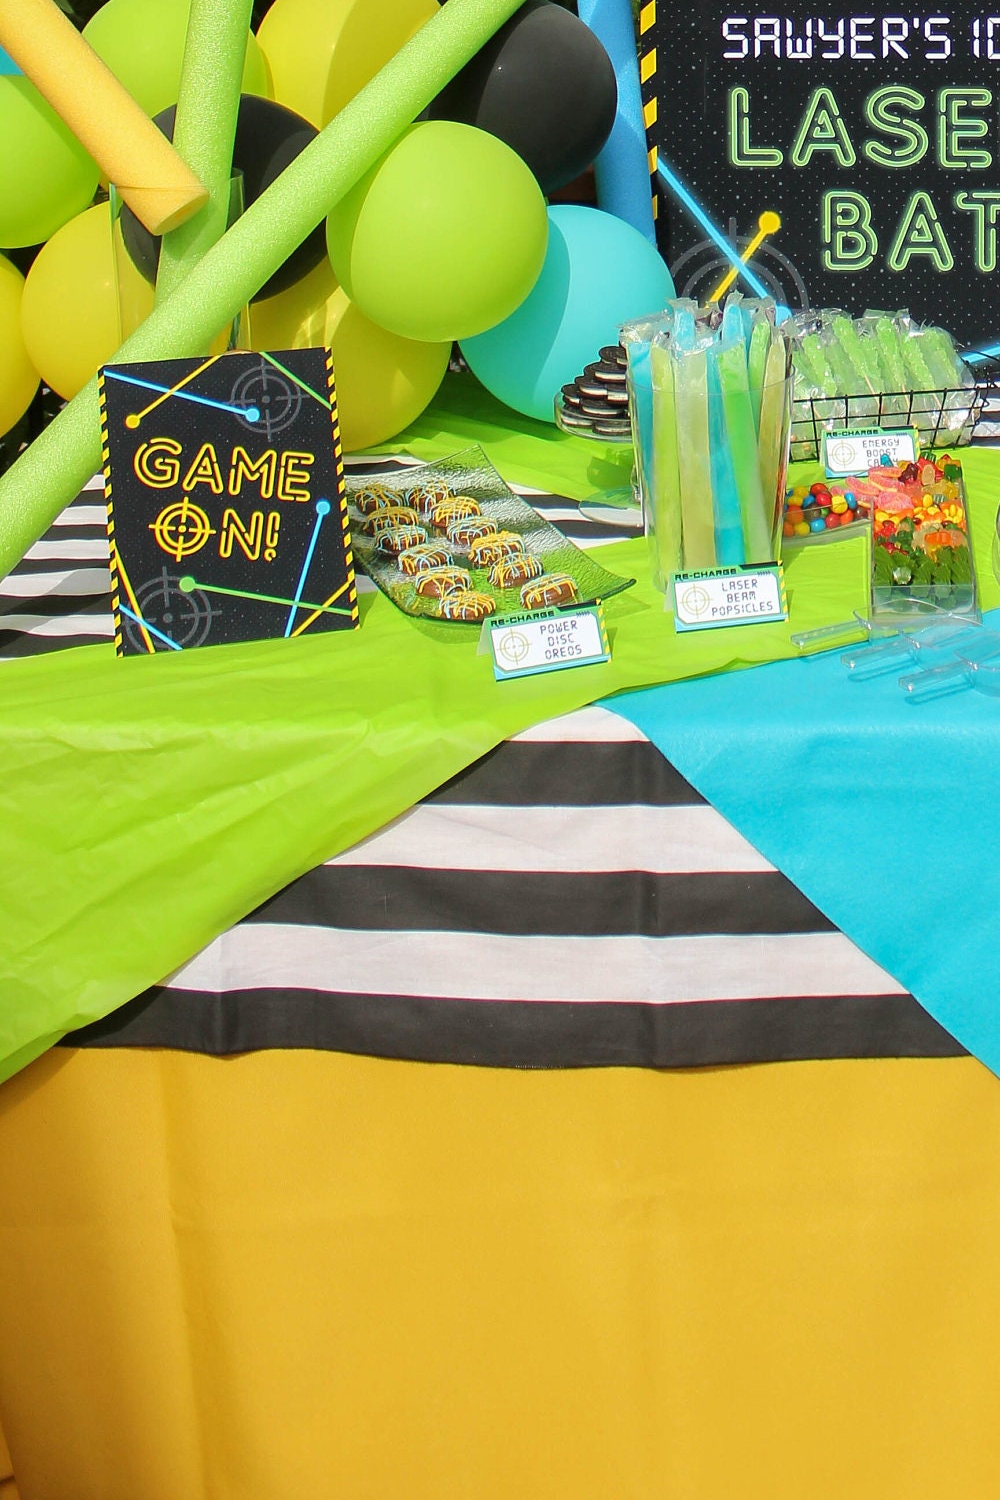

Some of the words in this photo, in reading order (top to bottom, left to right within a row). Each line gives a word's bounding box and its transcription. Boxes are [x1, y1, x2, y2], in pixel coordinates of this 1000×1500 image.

[722, 16, 952, 60] SAWYER'S
[826, 429, 879, 438] RE-CHARGE
[862, 438, 900, 448] ENERGY
[866, 448, 897, 458] BOOST
[133, 437, 315, 502] GAME
[867, 458, 898, 467] CAY
[148, 496, 281, 562] ON!
[675, 568, 737, 581] RE-CHARGE
[721, 579, 758, 591] LASER
[727, 591, 756, 603] BEAM
[711, 601, 773, 617] POPSICLES
[490, 610, 555, 627] RE-CHARGE
[540, 619, 578, 635] POWER
[547, 633, 575, 647] DISC
[544, 644, 582, 660] OREOS
